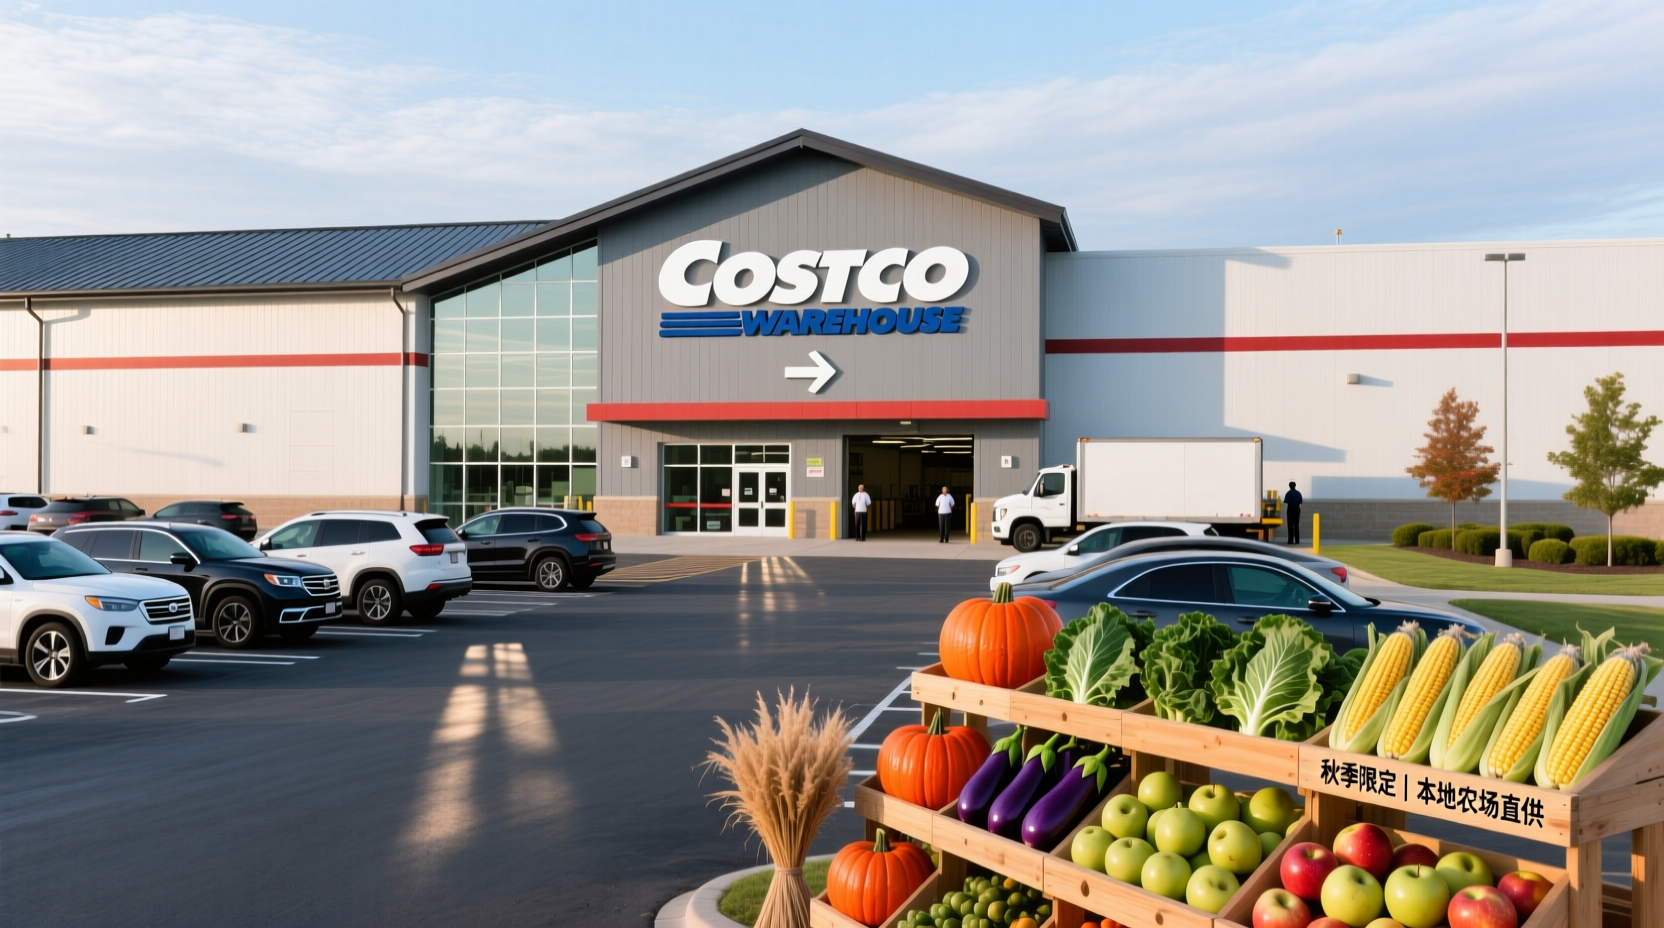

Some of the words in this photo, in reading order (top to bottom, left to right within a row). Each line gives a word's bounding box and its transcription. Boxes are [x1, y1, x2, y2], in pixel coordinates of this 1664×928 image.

[742, 306, 963, 337] WAREHOUSE
[1320, 758, 1396, 798] 秋季限定
[1416, 776, 1545, 829] 本地农场直供
